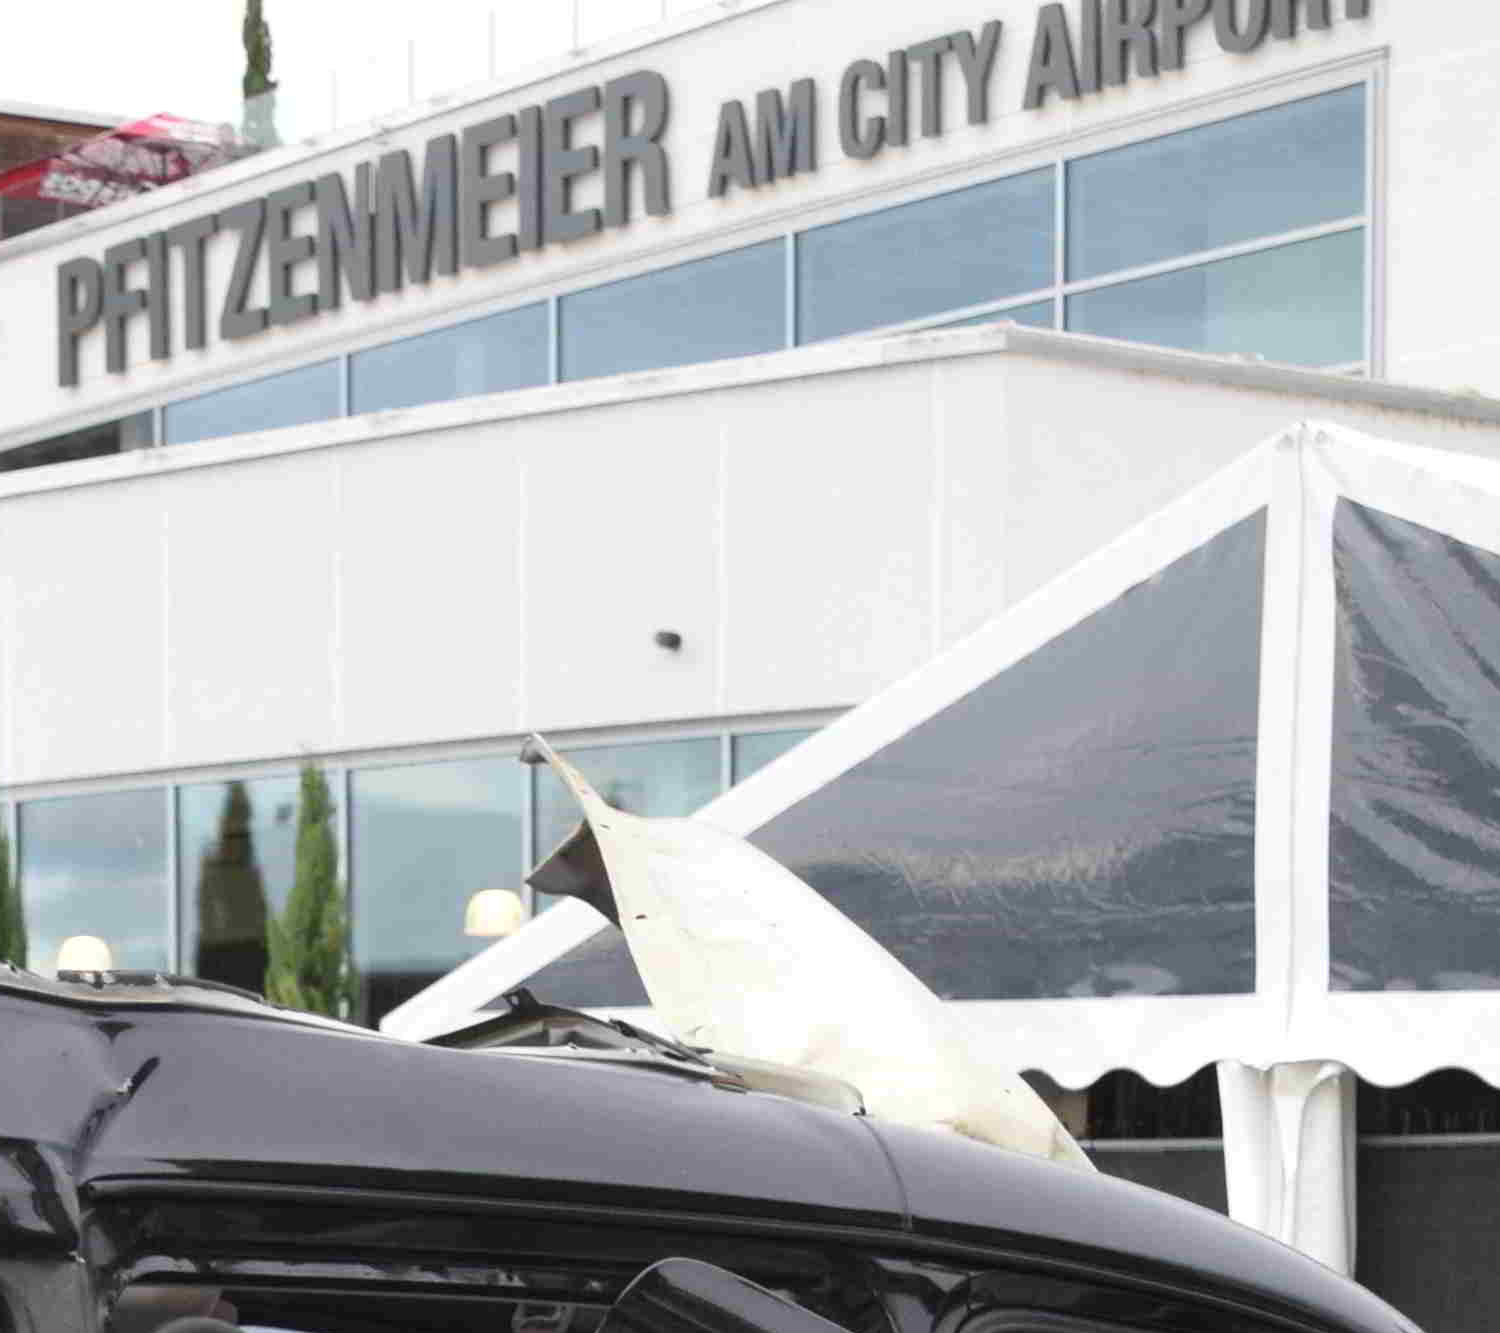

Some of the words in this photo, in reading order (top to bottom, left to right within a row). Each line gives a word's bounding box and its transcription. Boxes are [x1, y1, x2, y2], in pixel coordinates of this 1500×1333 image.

[56, 69, 672, 388] PFITZENMEIER
[707, 77, 817, 199] AM
[837, 19, 1003, 161] CITY
[1021, 0, 1373, 111] AIRPO
